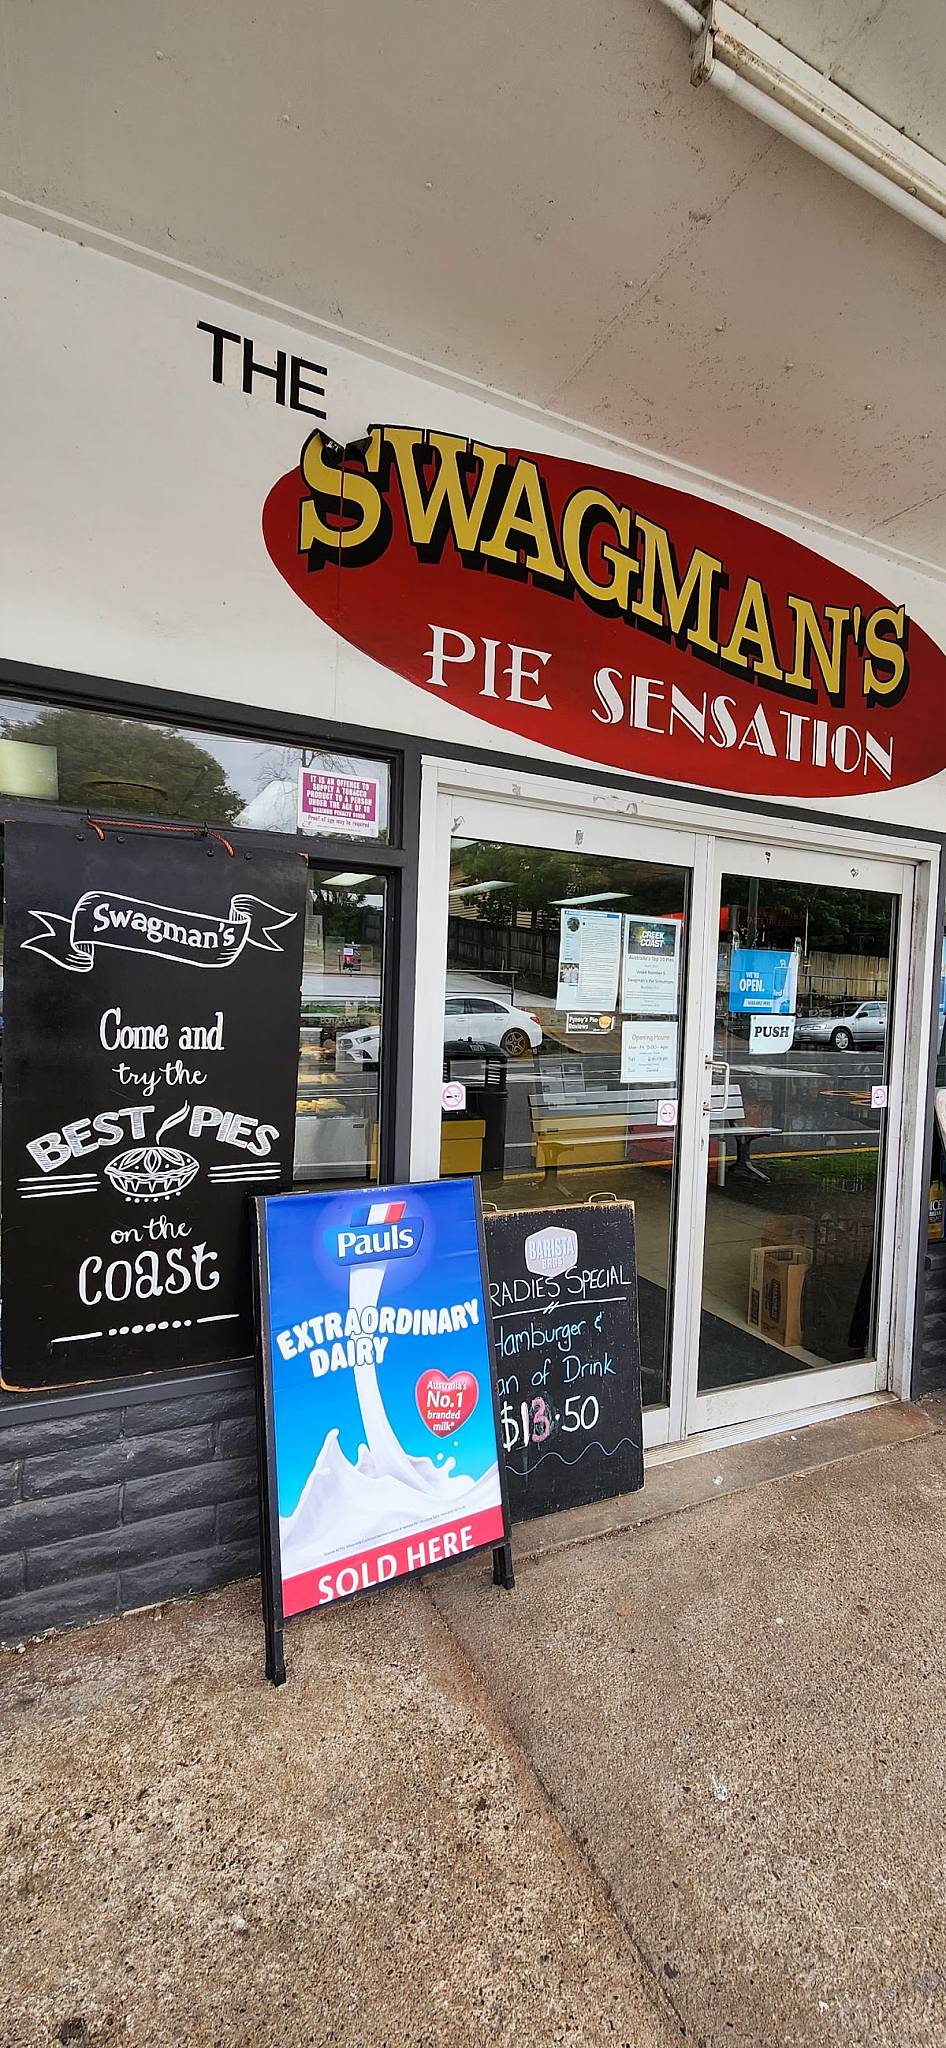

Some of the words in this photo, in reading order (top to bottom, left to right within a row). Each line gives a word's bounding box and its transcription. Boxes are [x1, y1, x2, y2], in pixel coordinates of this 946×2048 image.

[198, 320, 328, 420] THE
[299, 424, 909, 706] SWAGMAN'S
[423, 624, 553, 711] PIE
[592, 667, 894, 782] SENSATION
[307, 790, 333, 800] PRODUCT
[335, 794, 342, 802] TO
[351, 797, 372, 806] PERSON
[313, 784, 333, 793] SUPPLY
[342, 788, 367, 797] TOBACCO
[319, 776, 325, 784] IS
[327, 777, 335, 785] AN
[337, 778, 360, 789] OFFENCE
[309, 798, 328, 807] UNDER
[329, 801, 341, 809] THE
[342, 803, 352, 811] AGE
[93, 903, 235, 949] Swagman's
[641, 939, 664, 948] COAST
[740, 979, 765, 992] OPEN.
[100, 1007, 169, 1051] Come
[178, 1011, 225, 1050] and
[754, 1026, 790, 1038] PUSH
[112, 1062, 161, 1096] try
[158, 1060, 207, 1086] the
[26, 1105, 155, 1173] BEST
[188, 1105, 280, 1156] PIES
[111, 1226, 143, 1244] on
[142, 1215, 192, 1241] the
[337, 1225, 414, 1258] Pauls
[529, 1236, 576, 1260] BARISTA
[489, 1276, 561, 1307] RADIES
[565, 1265, 632, 1299] SPECIAL
[276, 1298, 480, 1360] EXTRAORDINARY
[309, 1336, 389, 1378] DAIRY
[497, 1375, 519, 1396] an
[532, 1358, 551, 1387] of
[562, 1352, 616, 1384] Drink
[427, 1381, 467, 1390] Australia's
[427, 1410, 461, 1420] branded
[318, 1554, 398, 1605] SOLD
[406, 1525, 475, 1572] HERE
